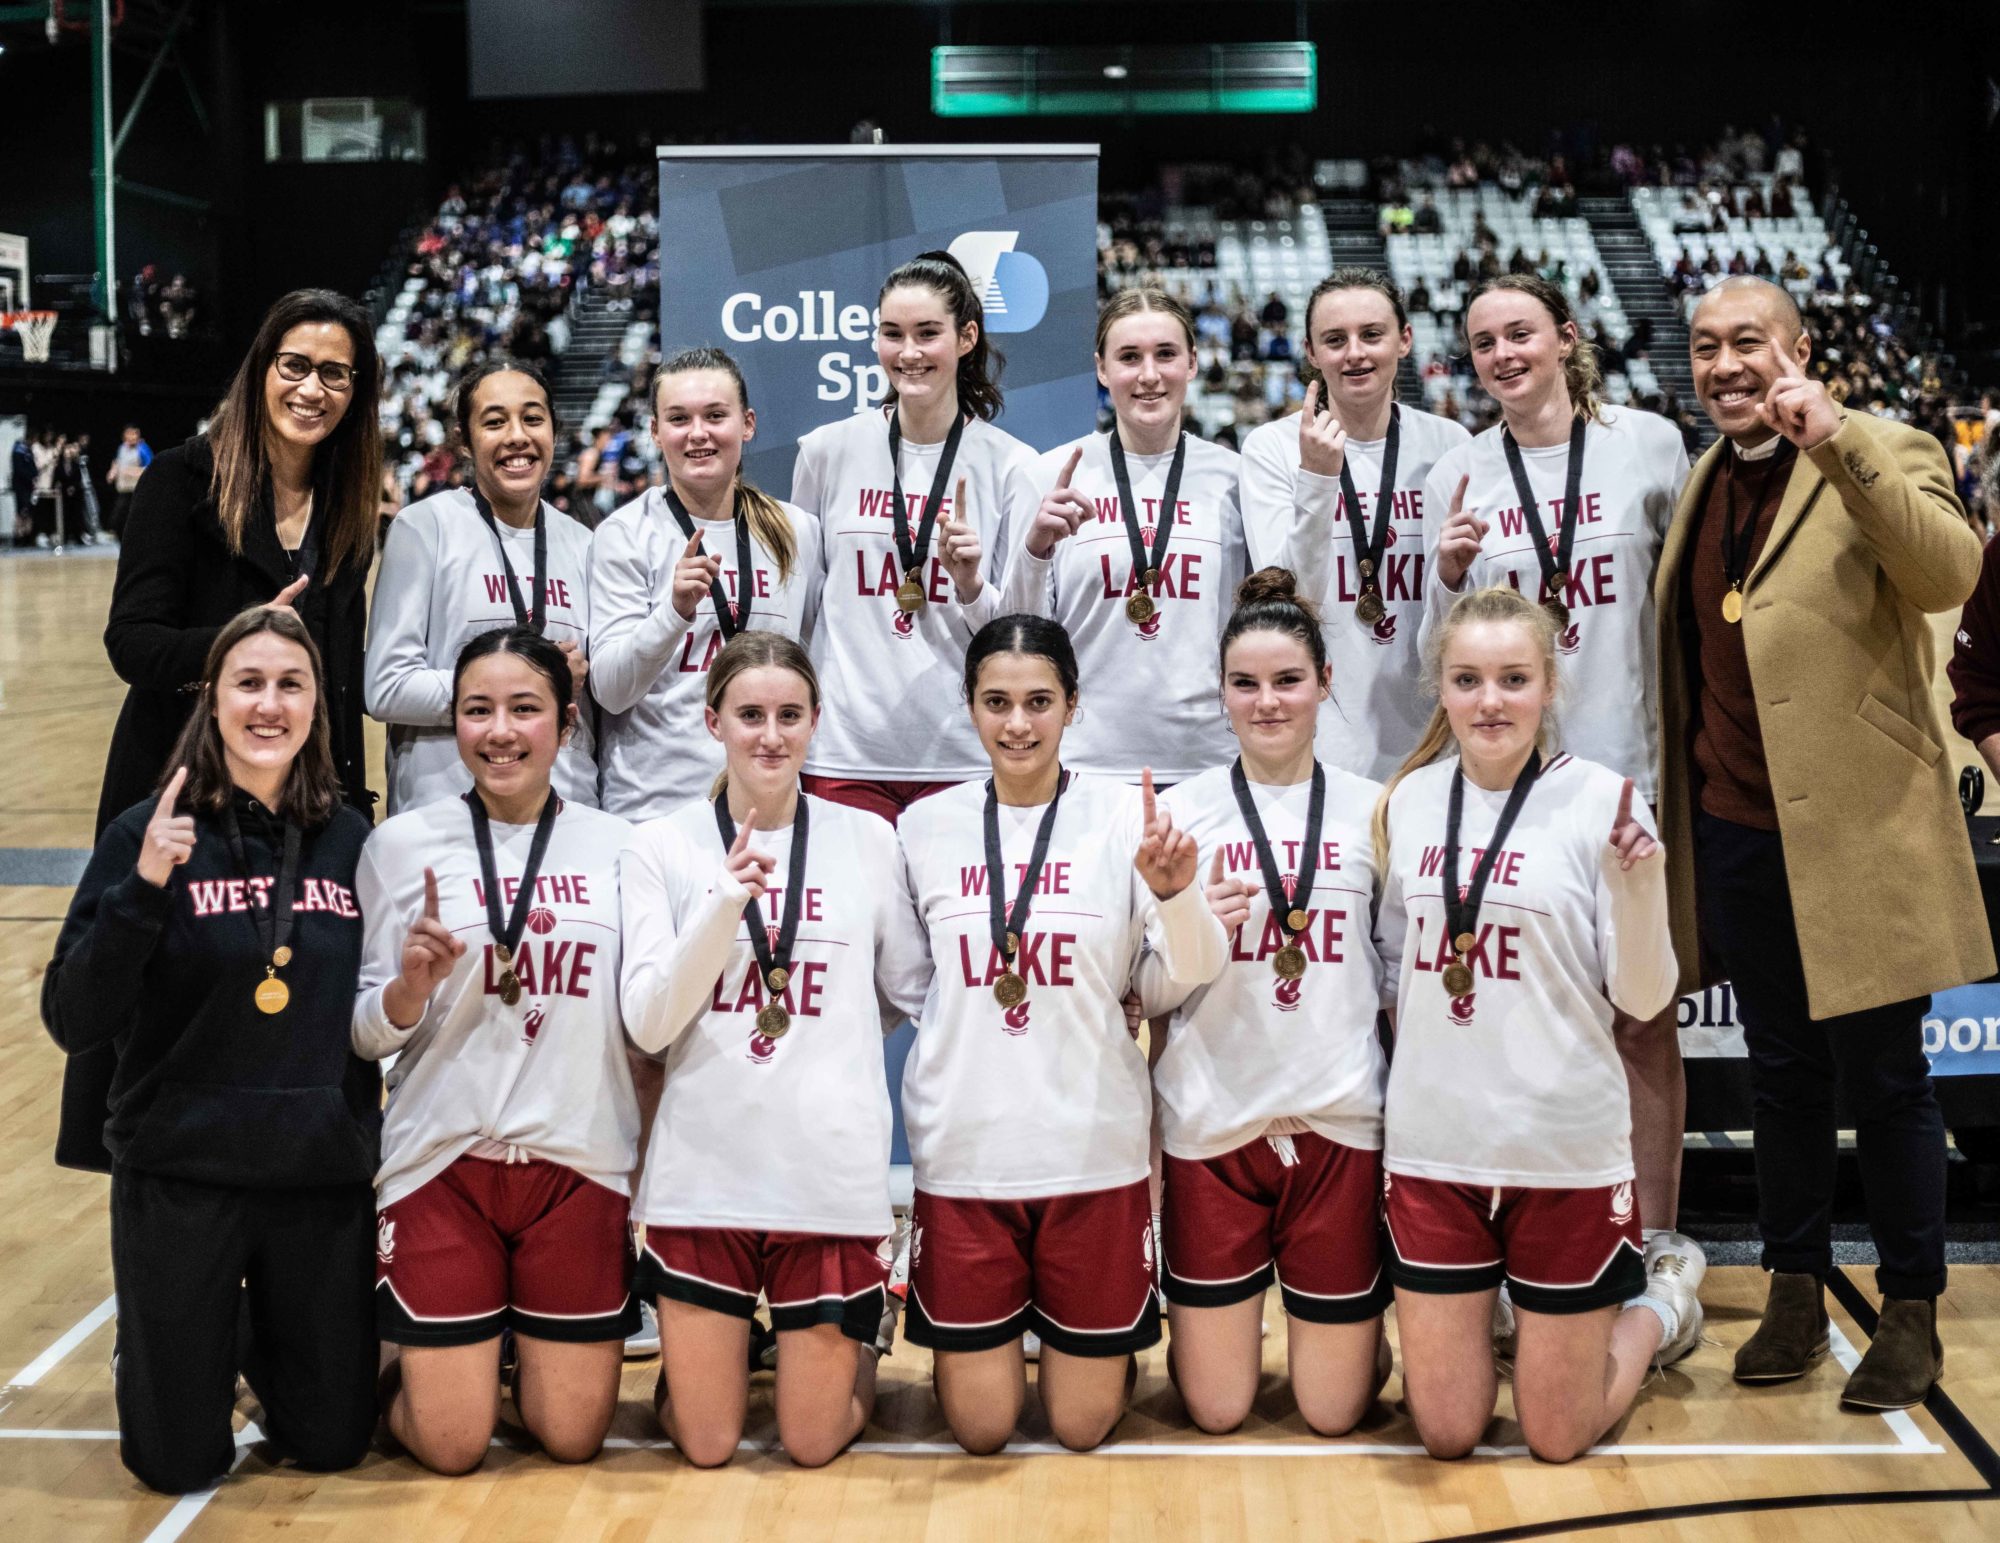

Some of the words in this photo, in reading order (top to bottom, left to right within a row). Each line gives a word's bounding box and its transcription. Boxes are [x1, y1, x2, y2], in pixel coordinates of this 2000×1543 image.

[817, 352, 890, 413] Sp
[1142, 498, 1191, 525] TE
[724, 569, 770, 598] TE
[857, 550, 948, 604] LAE
[1282, 840, 1341, 871] TE
[189, 877, 360, 917] WESAKE
[765, 888, 823, 921] TE
[484, 941, 597, 999] LAKE
